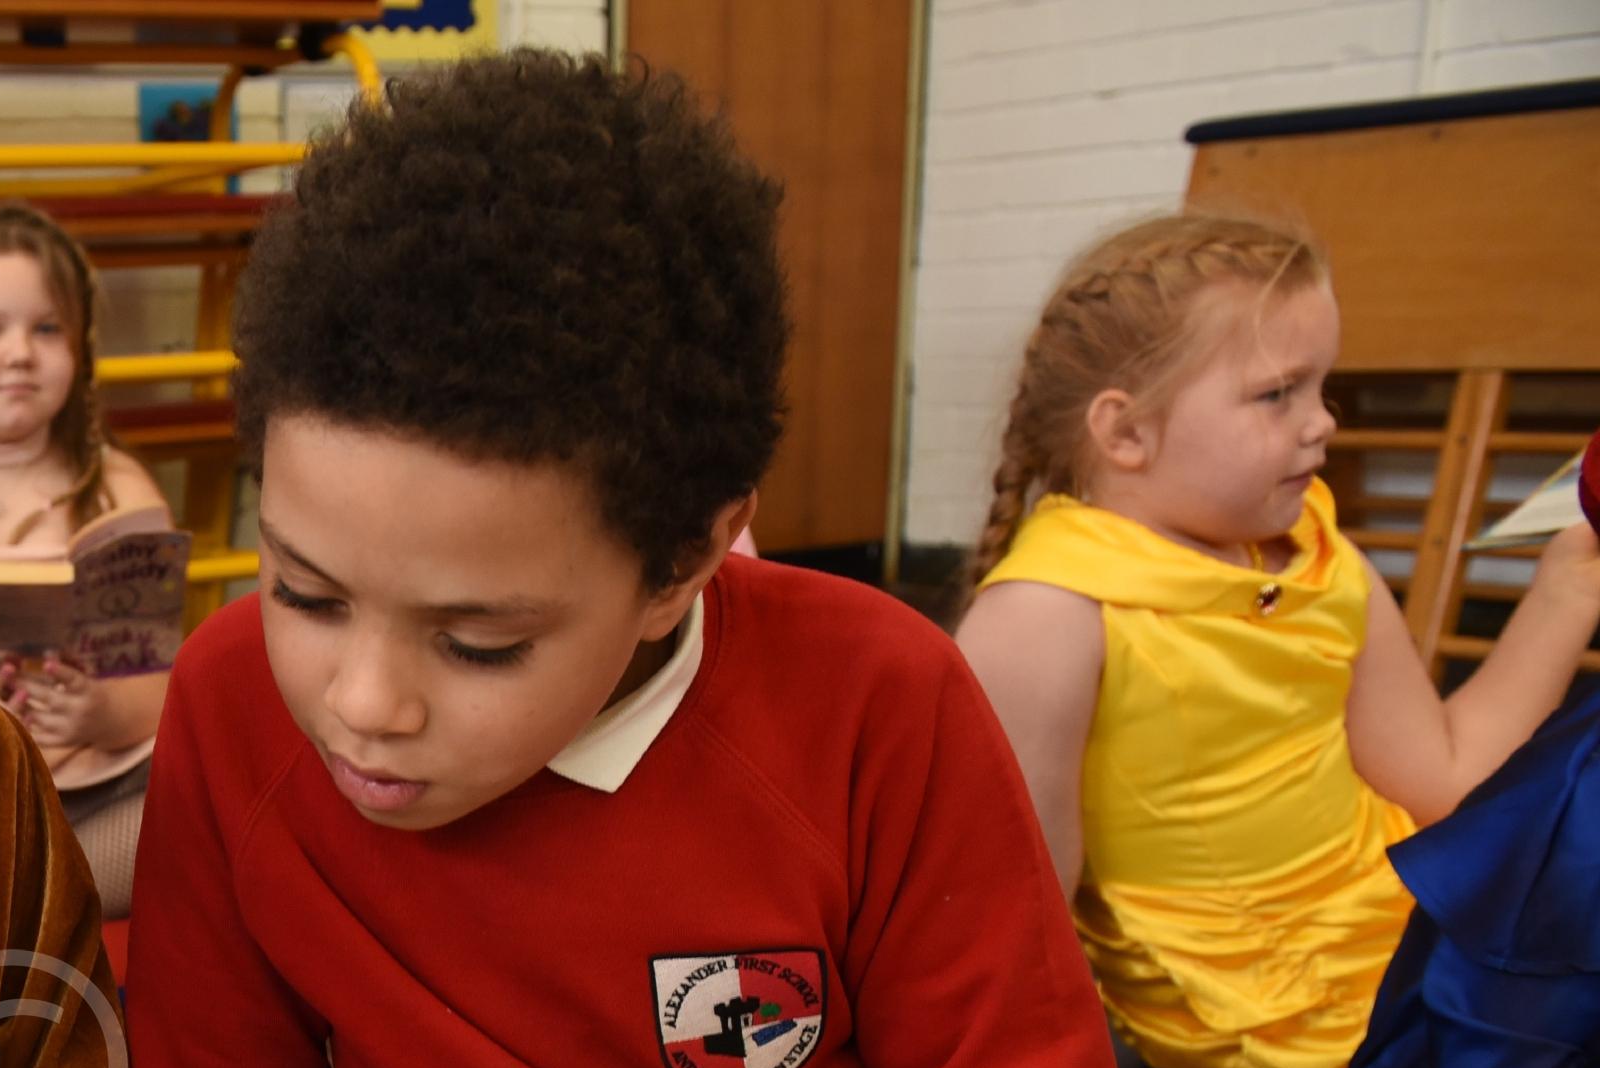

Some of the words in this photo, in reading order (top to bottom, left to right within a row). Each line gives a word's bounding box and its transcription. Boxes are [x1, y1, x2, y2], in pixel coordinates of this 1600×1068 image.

[664, 958, 728, 1030] ALEXANDER
[734, 956, 781, 976] FIRST
[784, 1024, 818, 1068] STAGE
